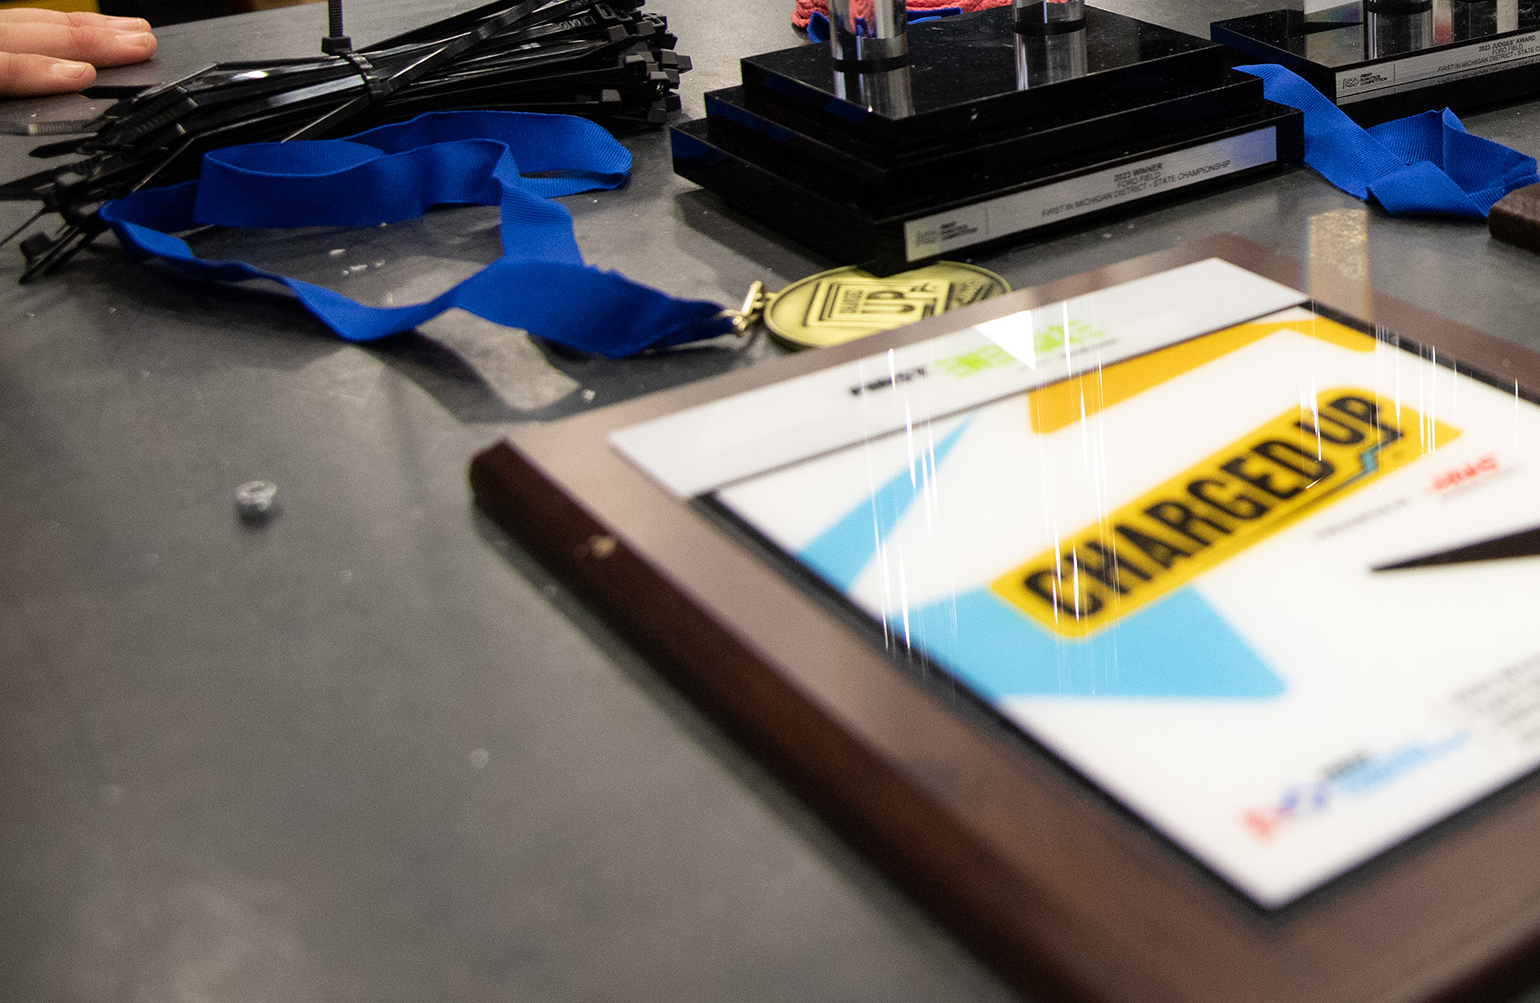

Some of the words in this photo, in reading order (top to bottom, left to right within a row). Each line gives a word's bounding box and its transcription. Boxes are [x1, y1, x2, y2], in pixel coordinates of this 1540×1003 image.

[1492, 47, 1507, 55] FORD
[1508, 43, 1524, 52] FIELD
[1515, 35, 1537, 45] AWARD
[1437, 64, 1454, 73] FIRST
[1460, 57, 1489, 68] MICHIGAN
[1489, 52, 1514, 63] DISTRICT
[1517, 47, 1535, 56] STATE
[1114, 183, 1148, 198] DISTRICT
[1153, 175, 1176, 188] STATE
[1177, 159, 1232, 181] CHAMPIONSHIP
[1024, 439, 1335, 619] CHARGED
[1294, 394, 1404, 446] UP
